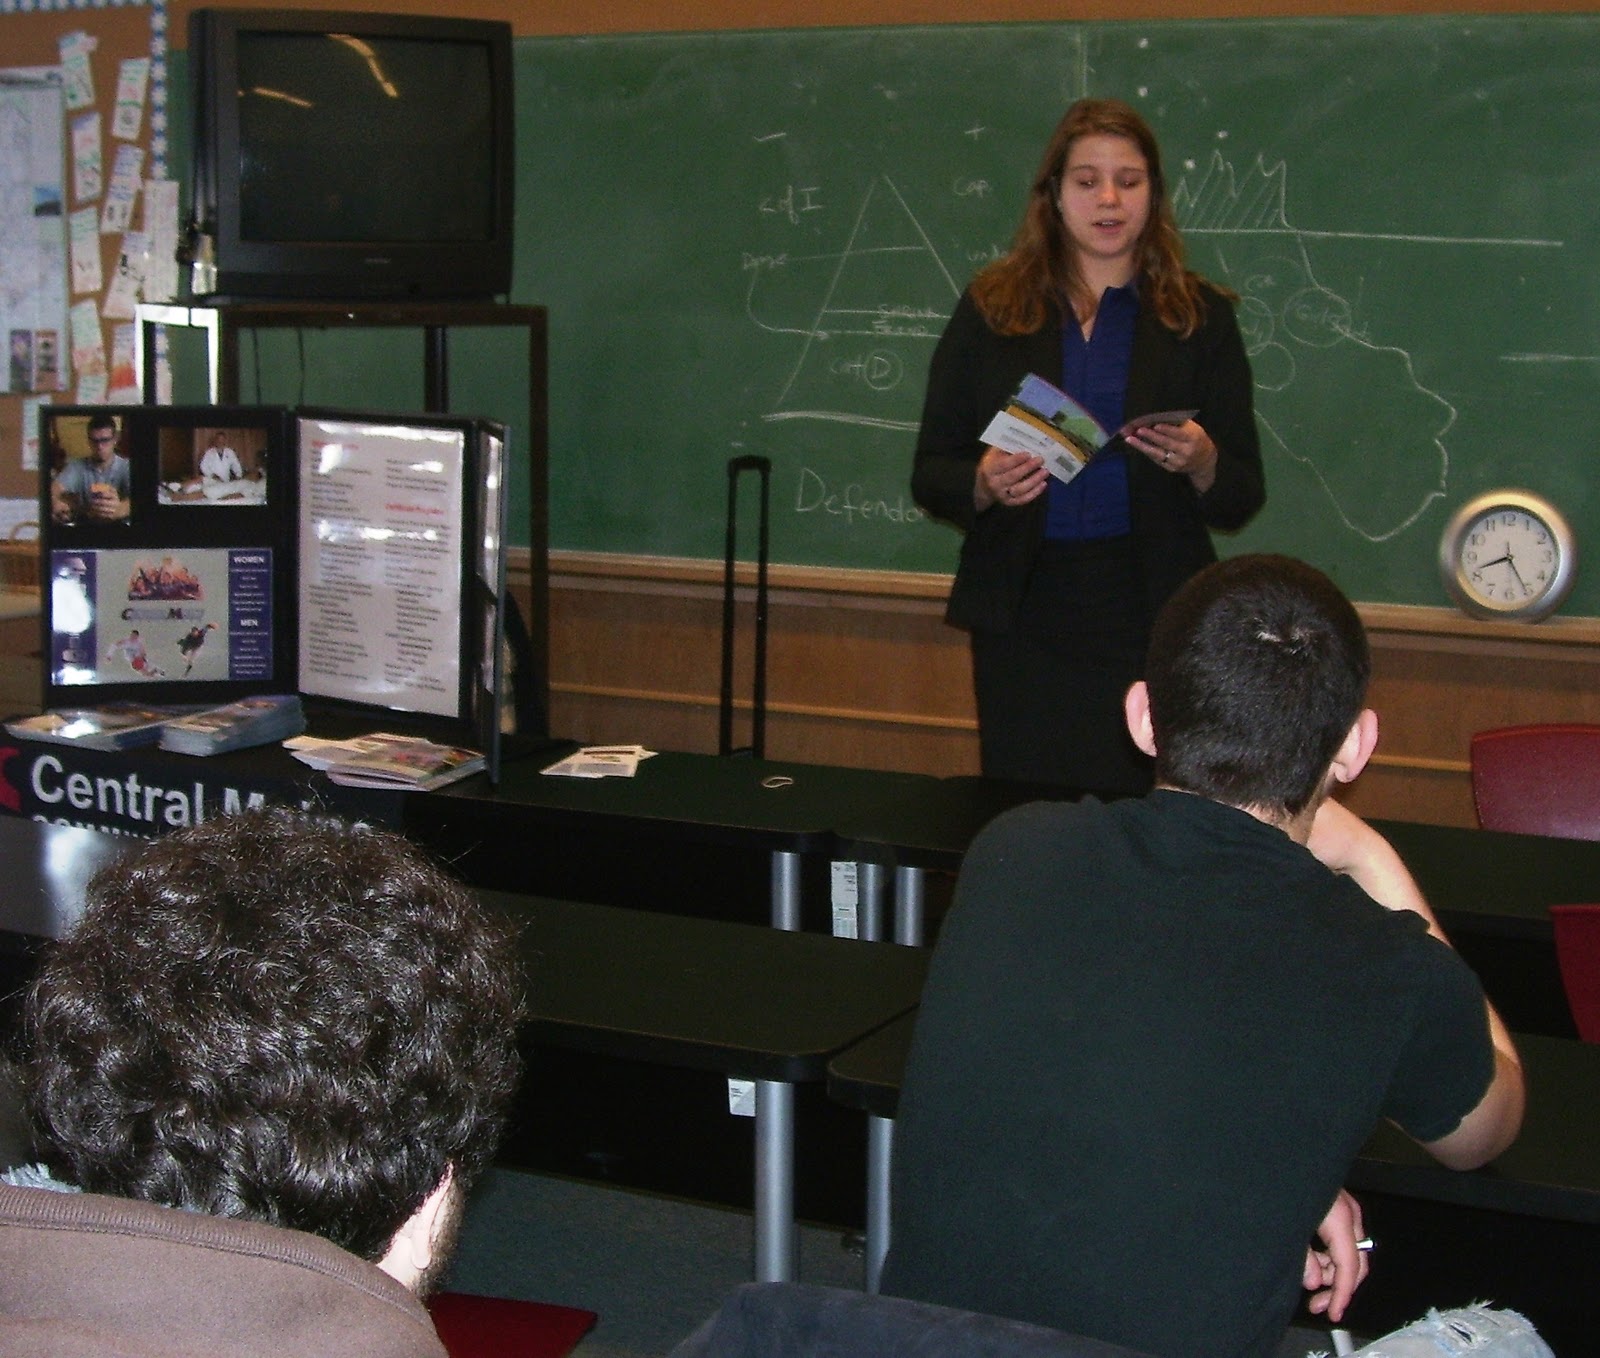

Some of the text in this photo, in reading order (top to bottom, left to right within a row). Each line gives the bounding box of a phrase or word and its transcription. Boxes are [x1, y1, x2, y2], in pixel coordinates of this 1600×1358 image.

[1503, 513, 1517, 527] 12
[1472, 534, 1486, 546] 10
[1537, 532, 1547, 545] 2
[233, 556, 265, 564] WOMEN
[1488, 583, 1496, 596] 7
[240, 619, 259, 627] MEN
[31, 753, 204, 828] Central
